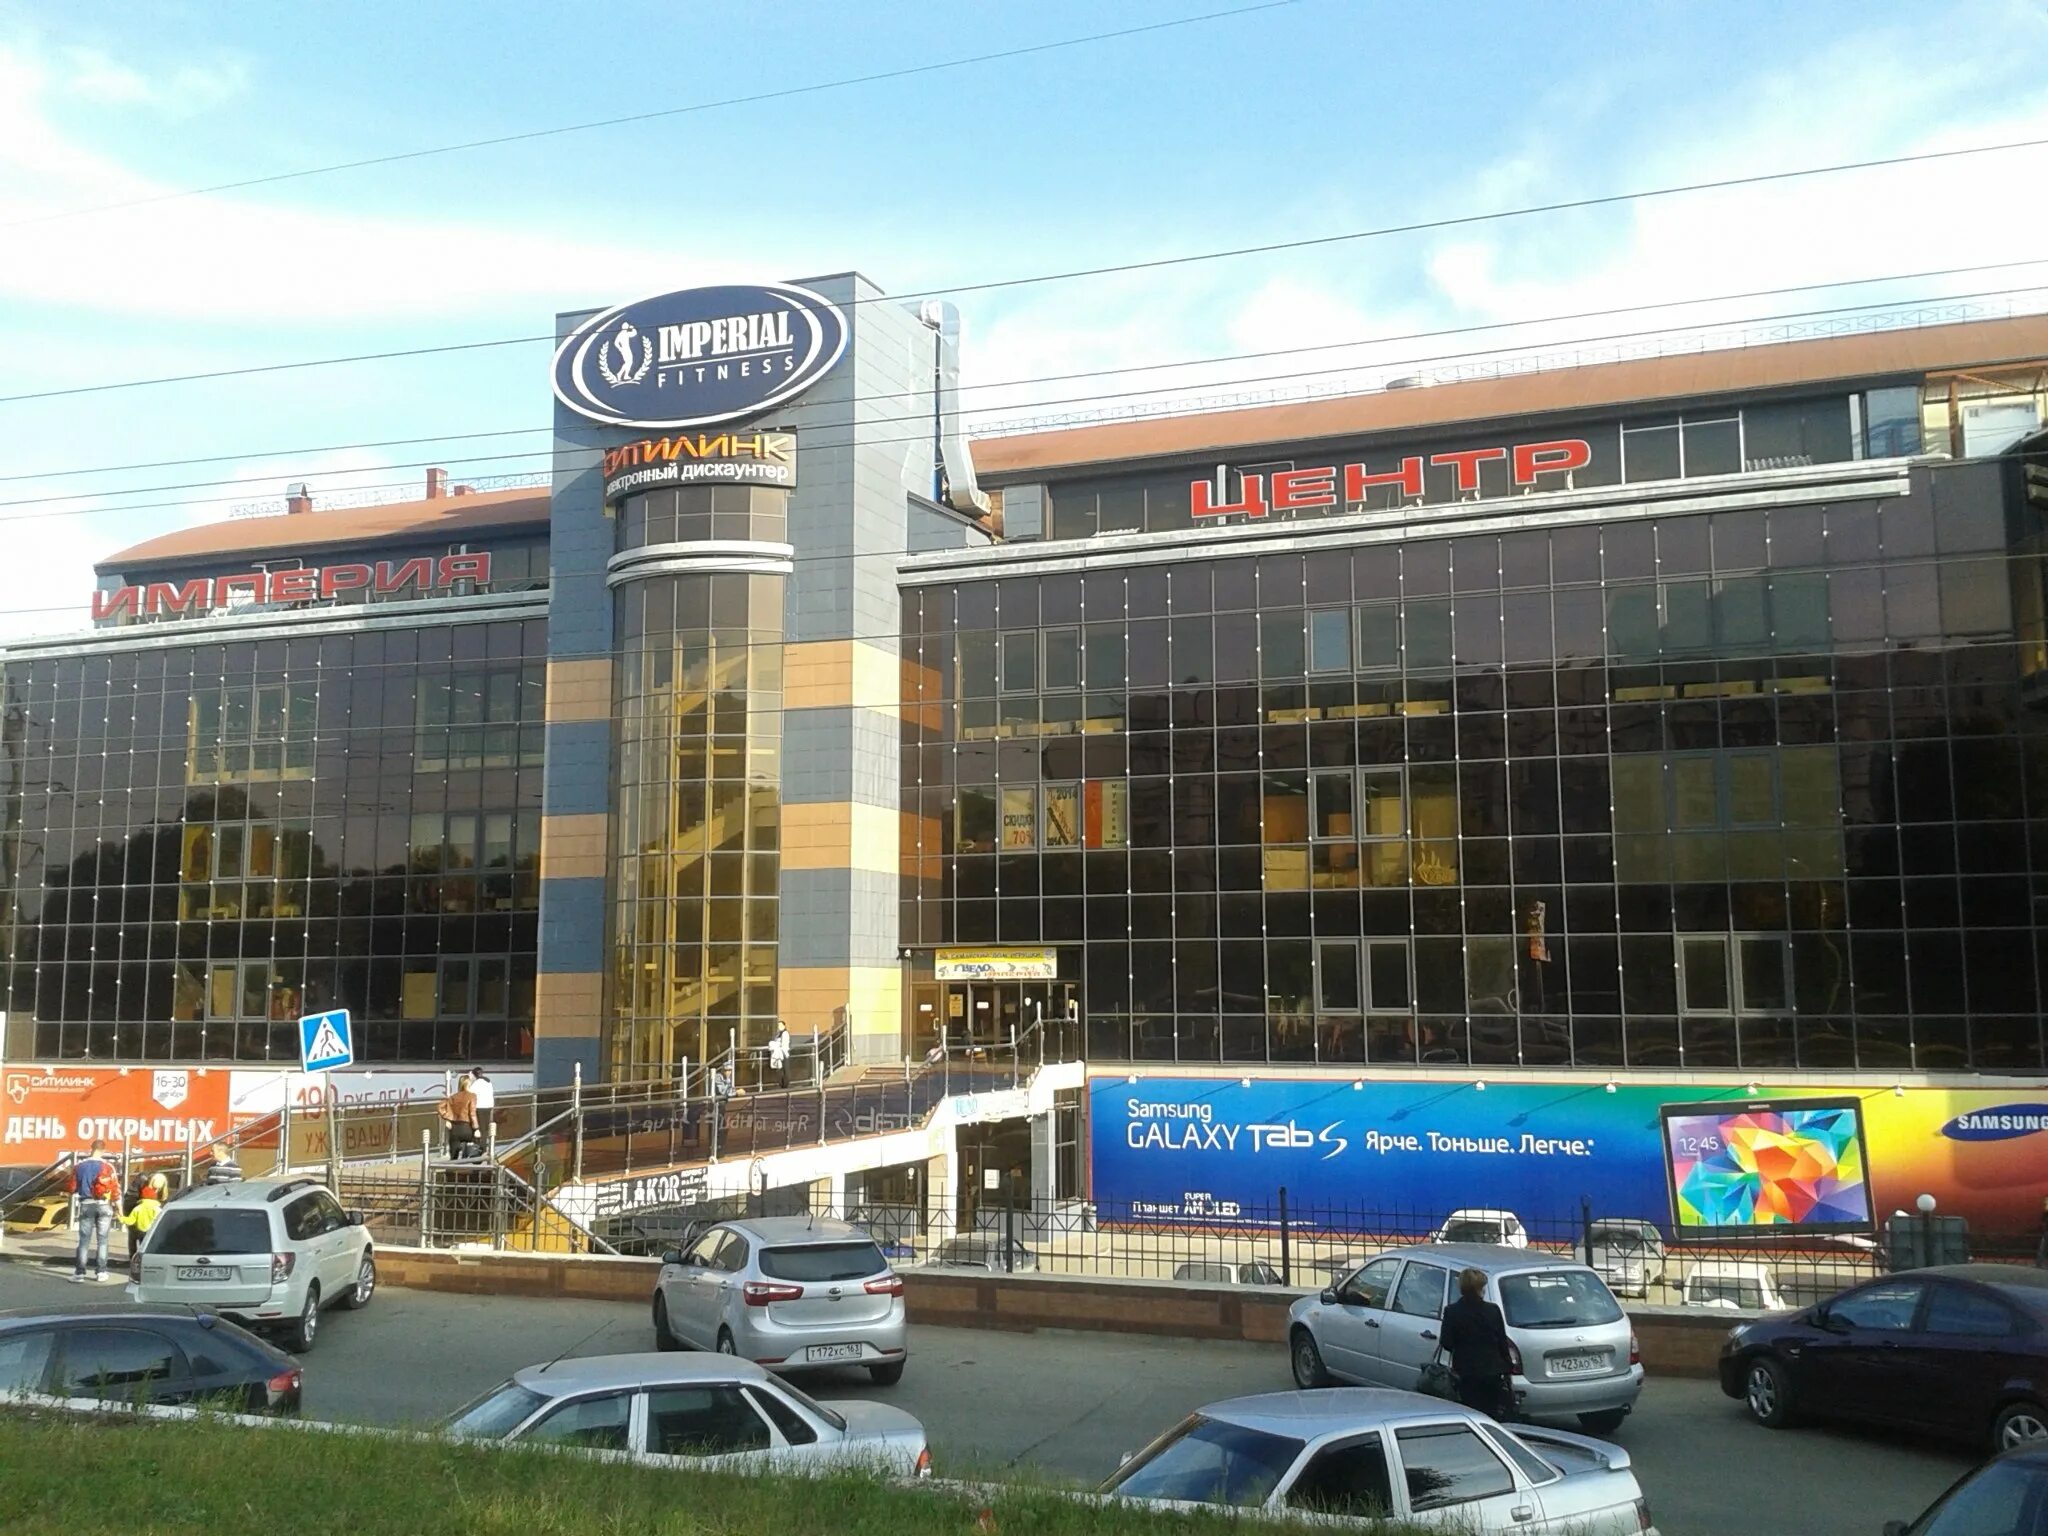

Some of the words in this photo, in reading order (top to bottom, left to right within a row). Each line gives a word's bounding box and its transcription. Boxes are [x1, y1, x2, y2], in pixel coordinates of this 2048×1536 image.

[657, 310, 794, 363] IMPERIAL
[657, 355, 795, 388] FITNESS
[681, 462, 789, 482] дискаунтер
[1190, 439, 1591, 519] ЦЕНТР
[92, 551, 491, 621] ИМПЕРИЯ
[31, 1076, 95, 1087] СИТИЛИНК
[155, 1075, 187, 1088] 16-30
[1127, 1099, 1213, 1123] Samsung
[4, 1116, 68, 1144] ДЕНЬ
[77, 1117, 215, 1143] ОТКРЫТЫХ
[1127, 1122, 1241, 1150] GALAXY
[1246, 1119, 1314, 1153] Tab
[1318, 1119, 1349, 1161] S
[1366, 1130, 1423, 1155] Ярче.
[1426, 1131, 1516, 1154] Тоньше.
